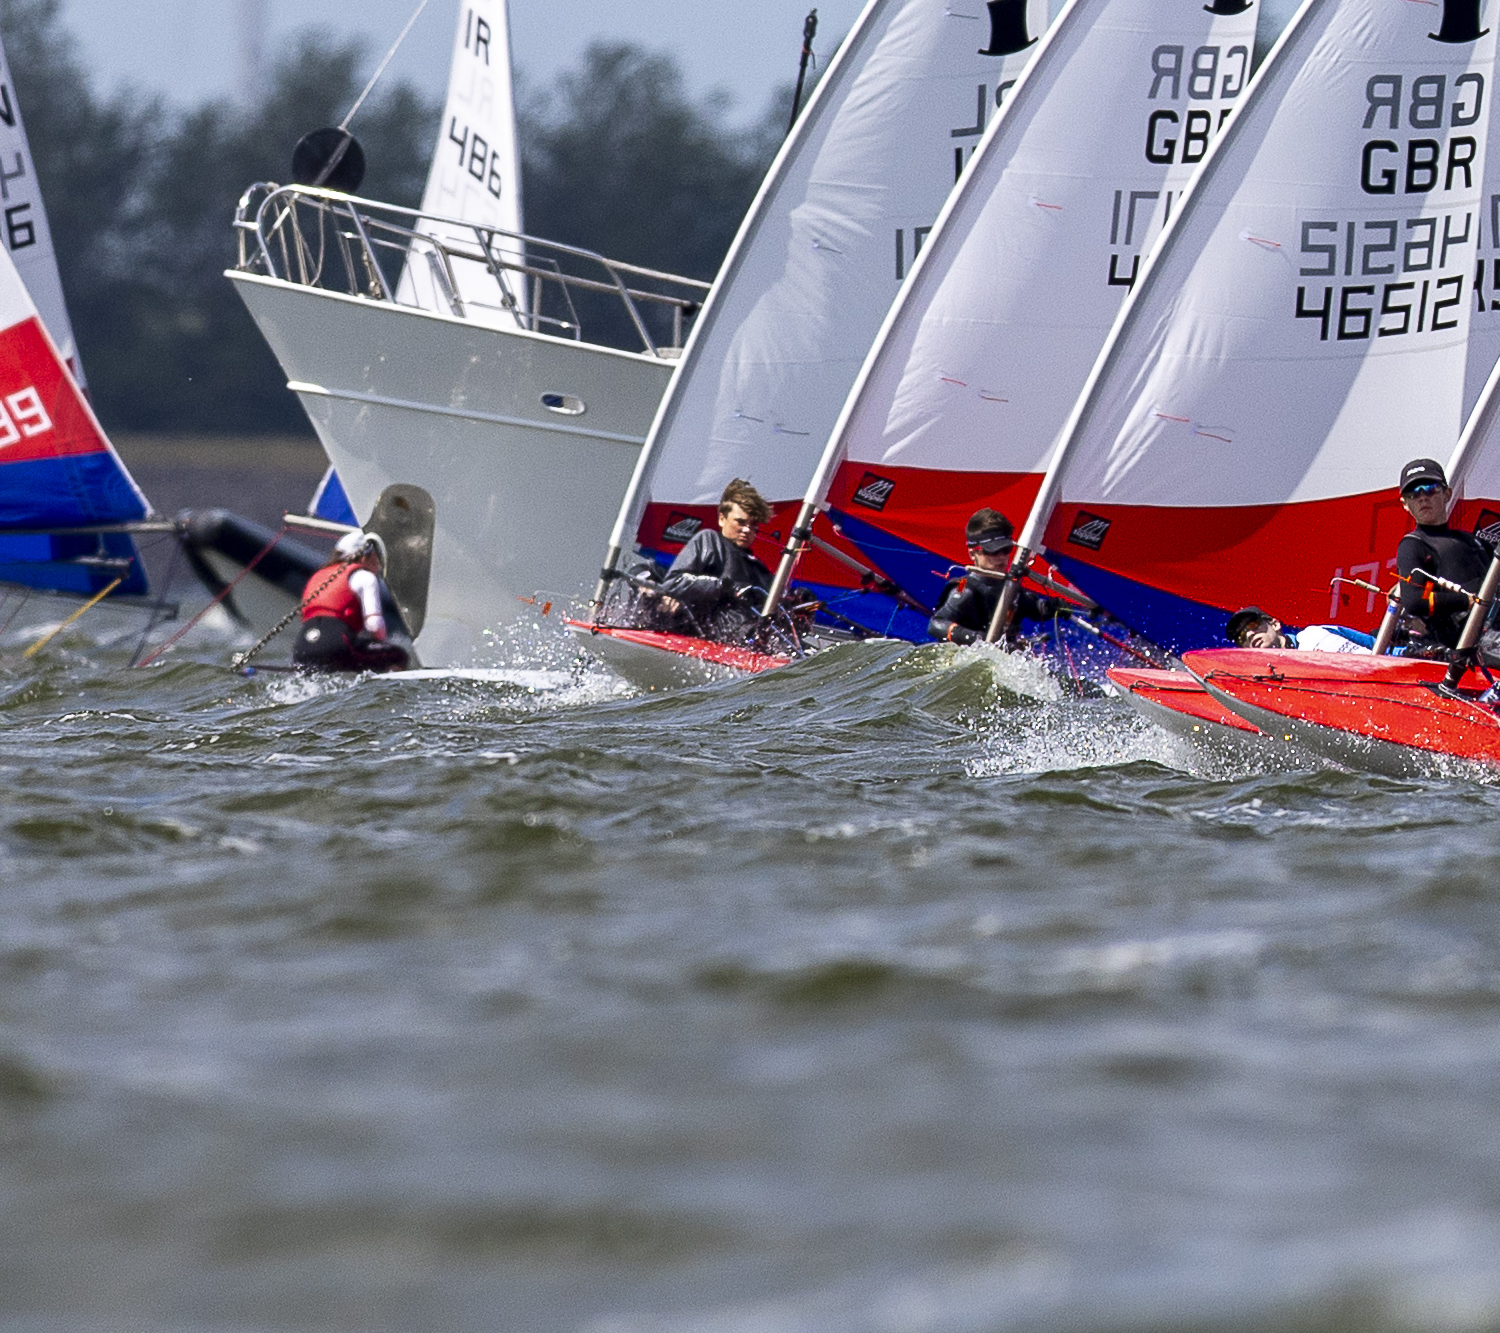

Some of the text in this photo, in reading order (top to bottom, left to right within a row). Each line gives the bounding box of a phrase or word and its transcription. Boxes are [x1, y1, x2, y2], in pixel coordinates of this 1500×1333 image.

[1361, 135, 1477, 195] GBR
[1295, 274, 1464, 341] 46512
[1329, 557, 1398, 619] 17
